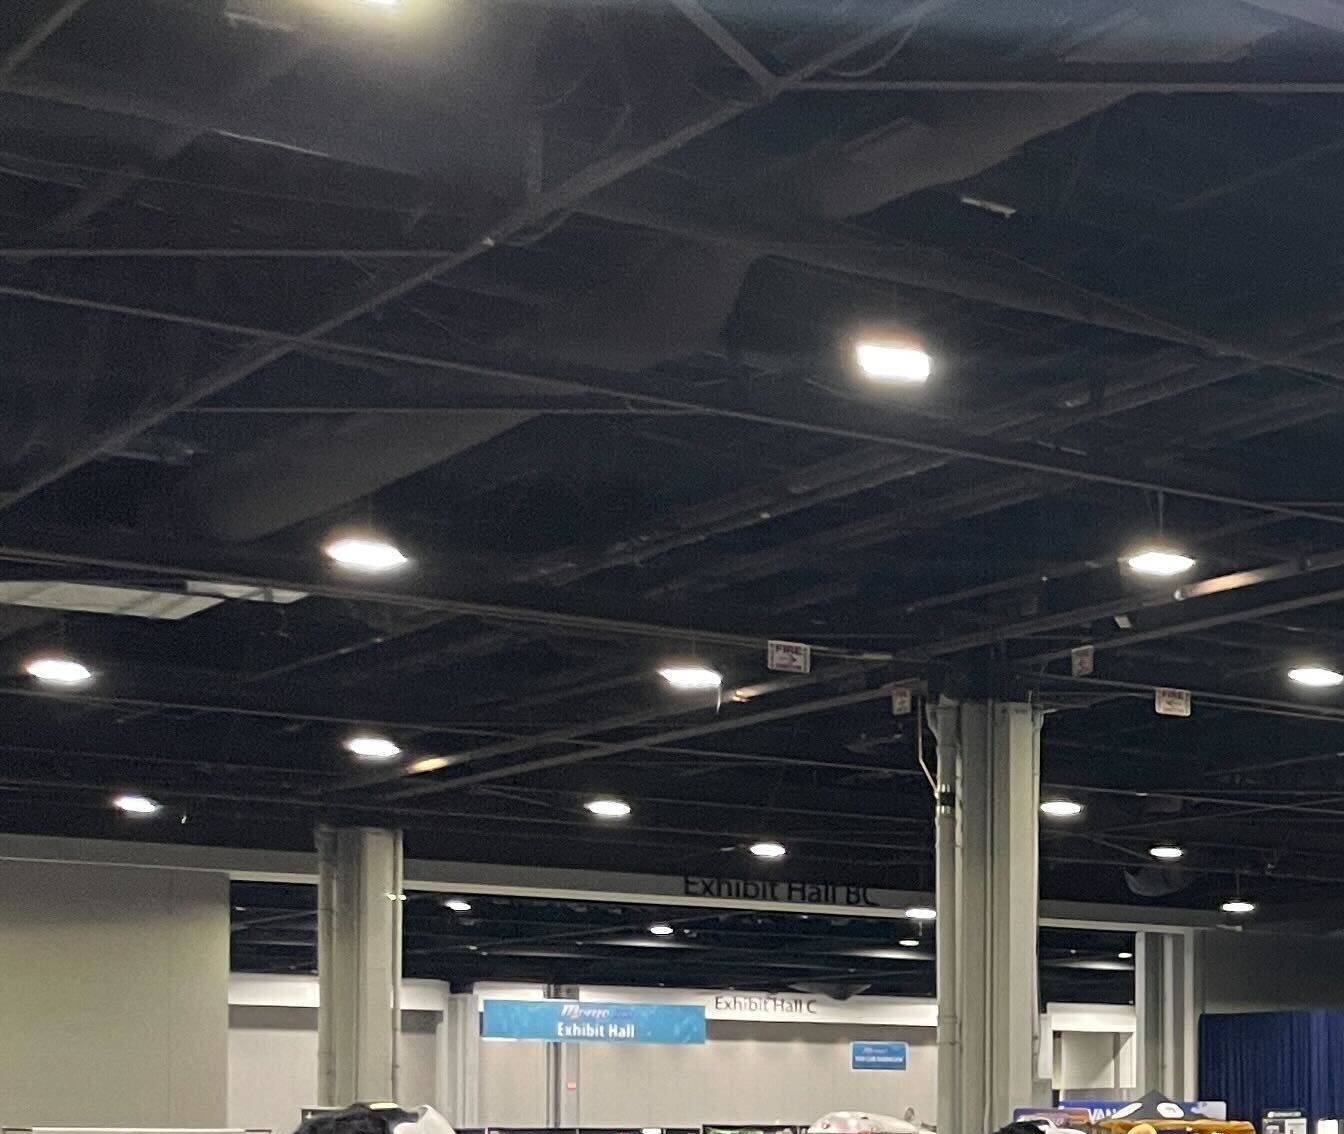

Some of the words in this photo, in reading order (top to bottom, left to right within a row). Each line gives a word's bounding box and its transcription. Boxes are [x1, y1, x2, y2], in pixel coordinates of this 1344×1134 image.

[684, 875, 781, 899] Exhibit
[788, 882, 837, 904] Hall
[714, 996, 770, 1013] Exhibit
[774, 998, 803, 1014] Hall
[806, 1000, 817, 1014] C
[557, 1022, 604, 1038] Exhibit
[608, 1023, 635, 1038] Hall
